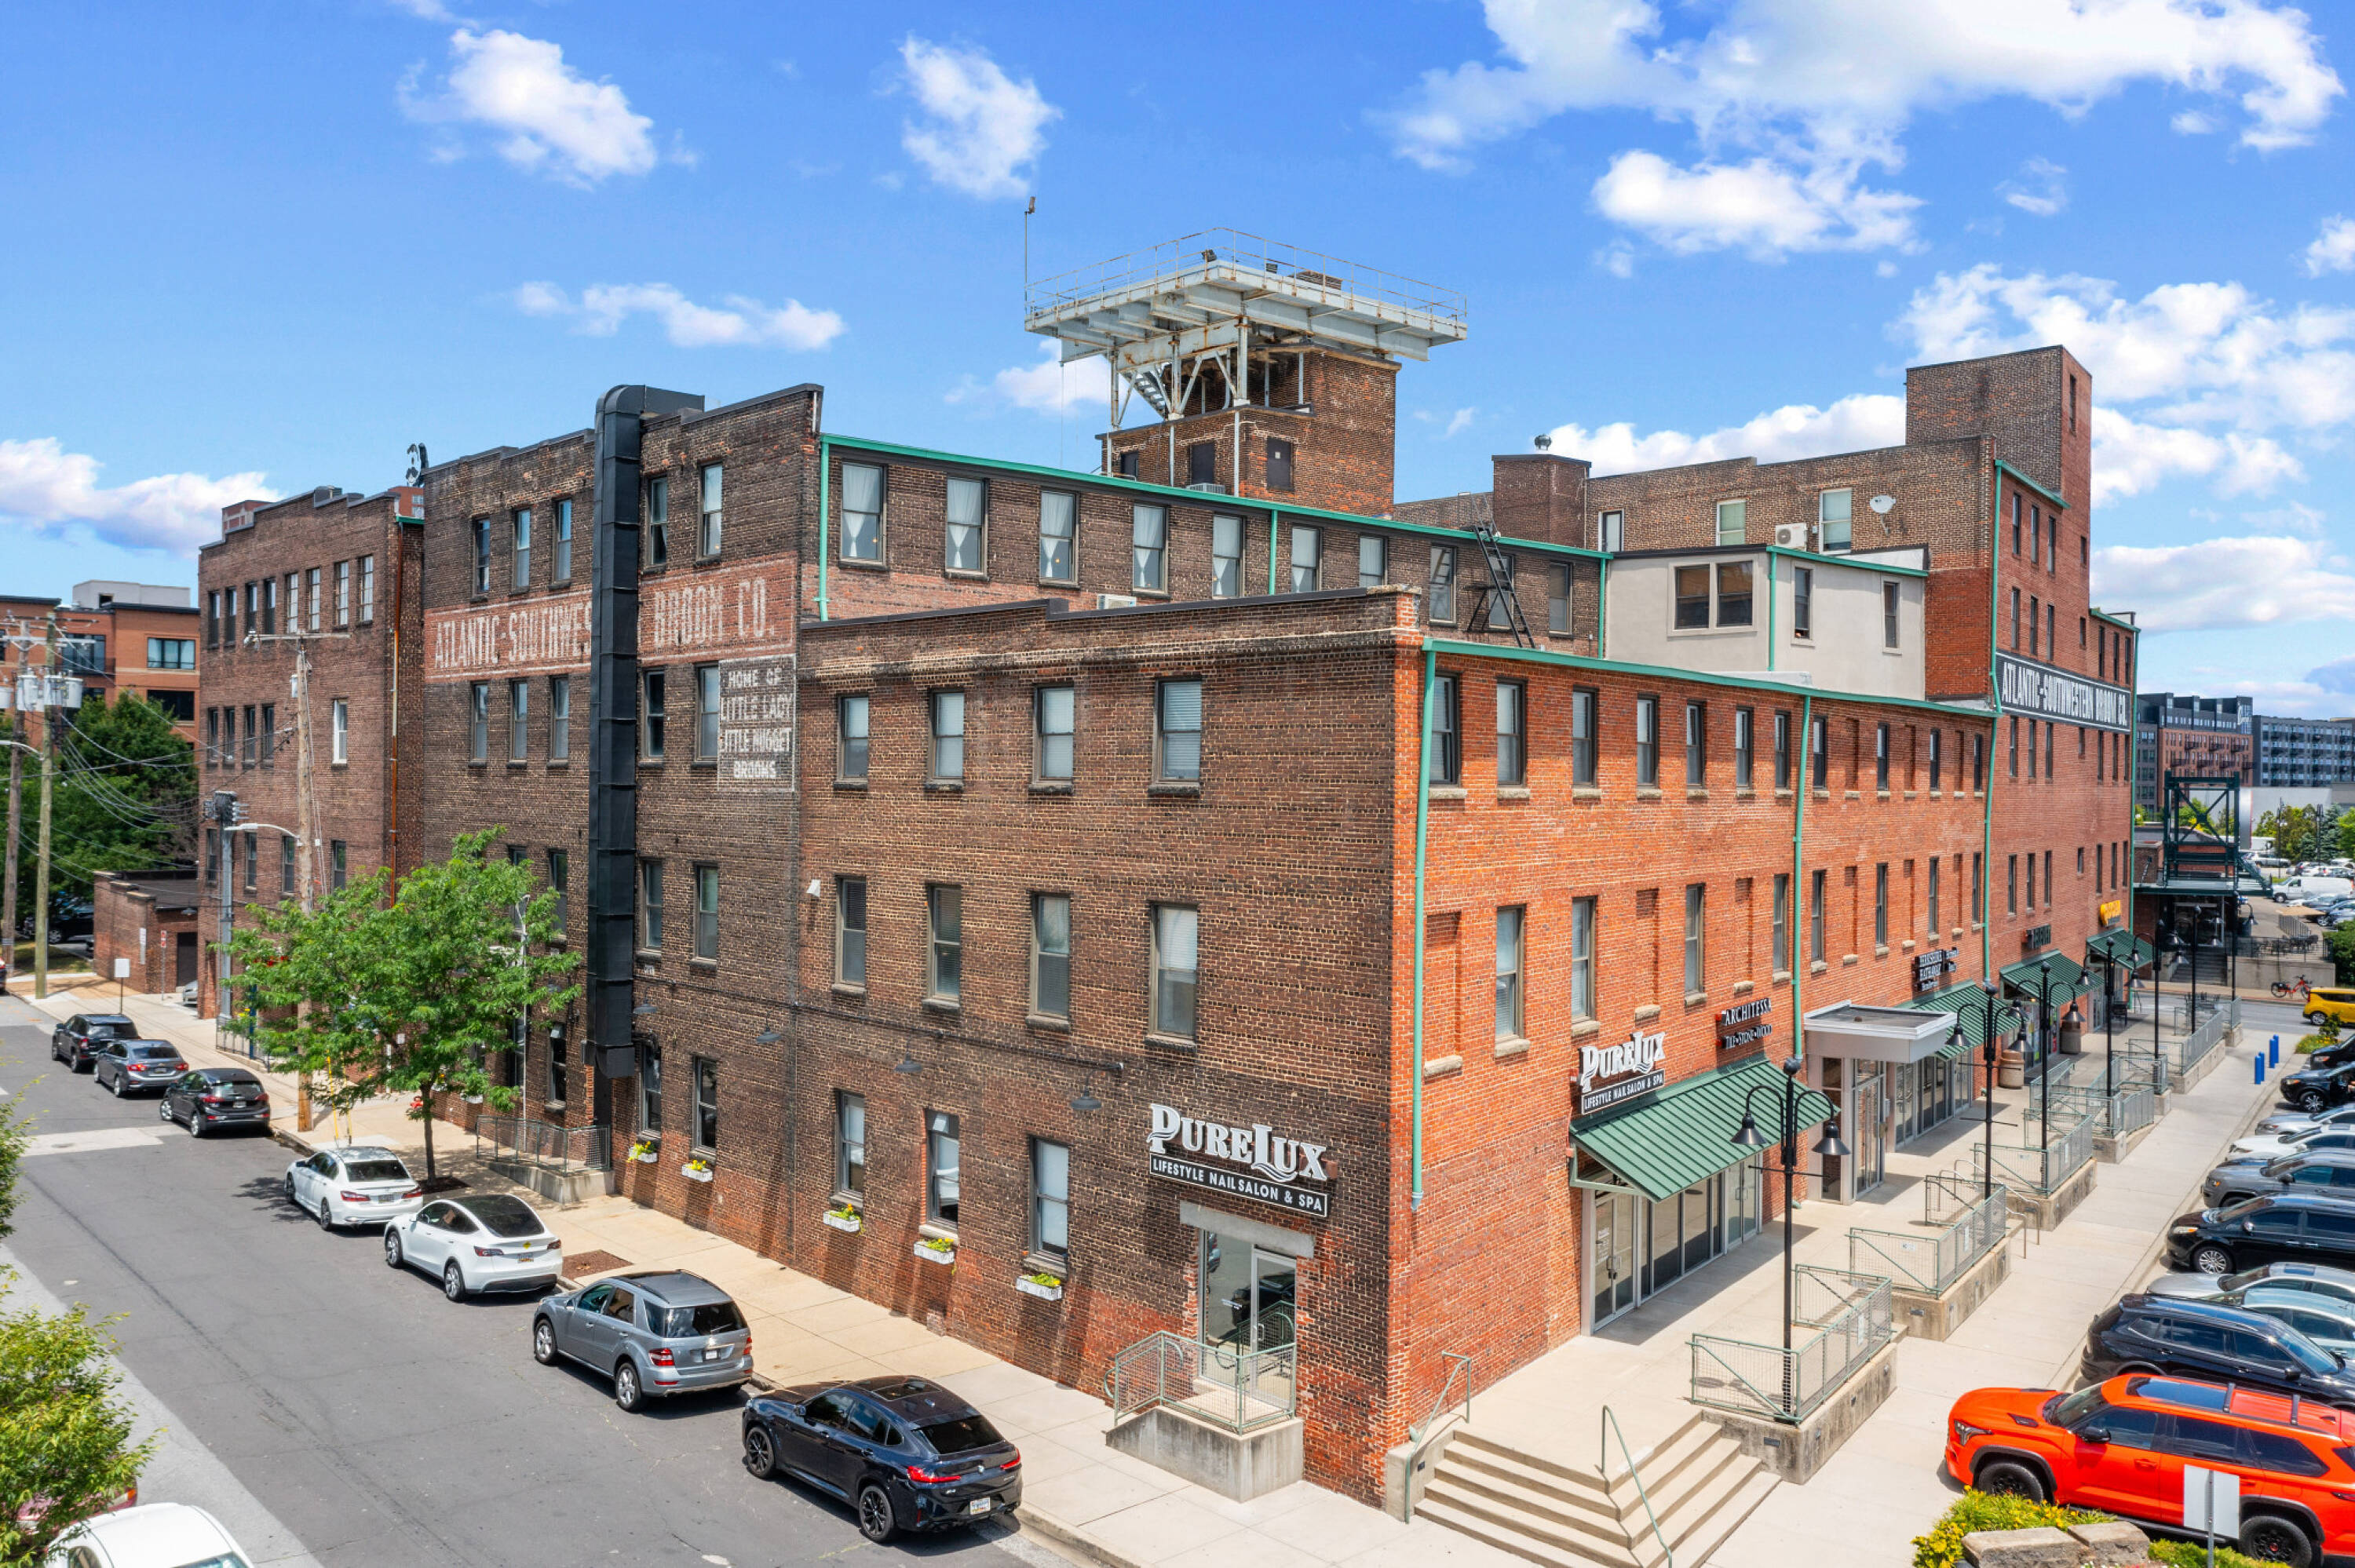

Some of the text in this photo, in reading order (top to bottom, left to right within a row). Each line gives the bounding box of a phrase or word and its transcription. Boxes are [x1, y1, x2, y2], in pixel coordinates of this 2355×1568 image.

[654, 584, 724, 650] BROOM
[739, 577, 775, 637] CO.
[728, 667, 783, 687] HOME OF
[721, 693, 793, 721] LITTLE LADY
[720, 727, 791, 753] LITTLE NUGGET
[734, 760, 776, 779] BROOMS
[1725, 997, 1772, 1026] ARCHITESSA
[1584, 1090, 1612, 1110] LIFESTYLE
[1652, 1073, 1663, 1086] SPA
[1152, 1158, 1323, 1212] LIFESTYLE NAIL SALON & SPA
